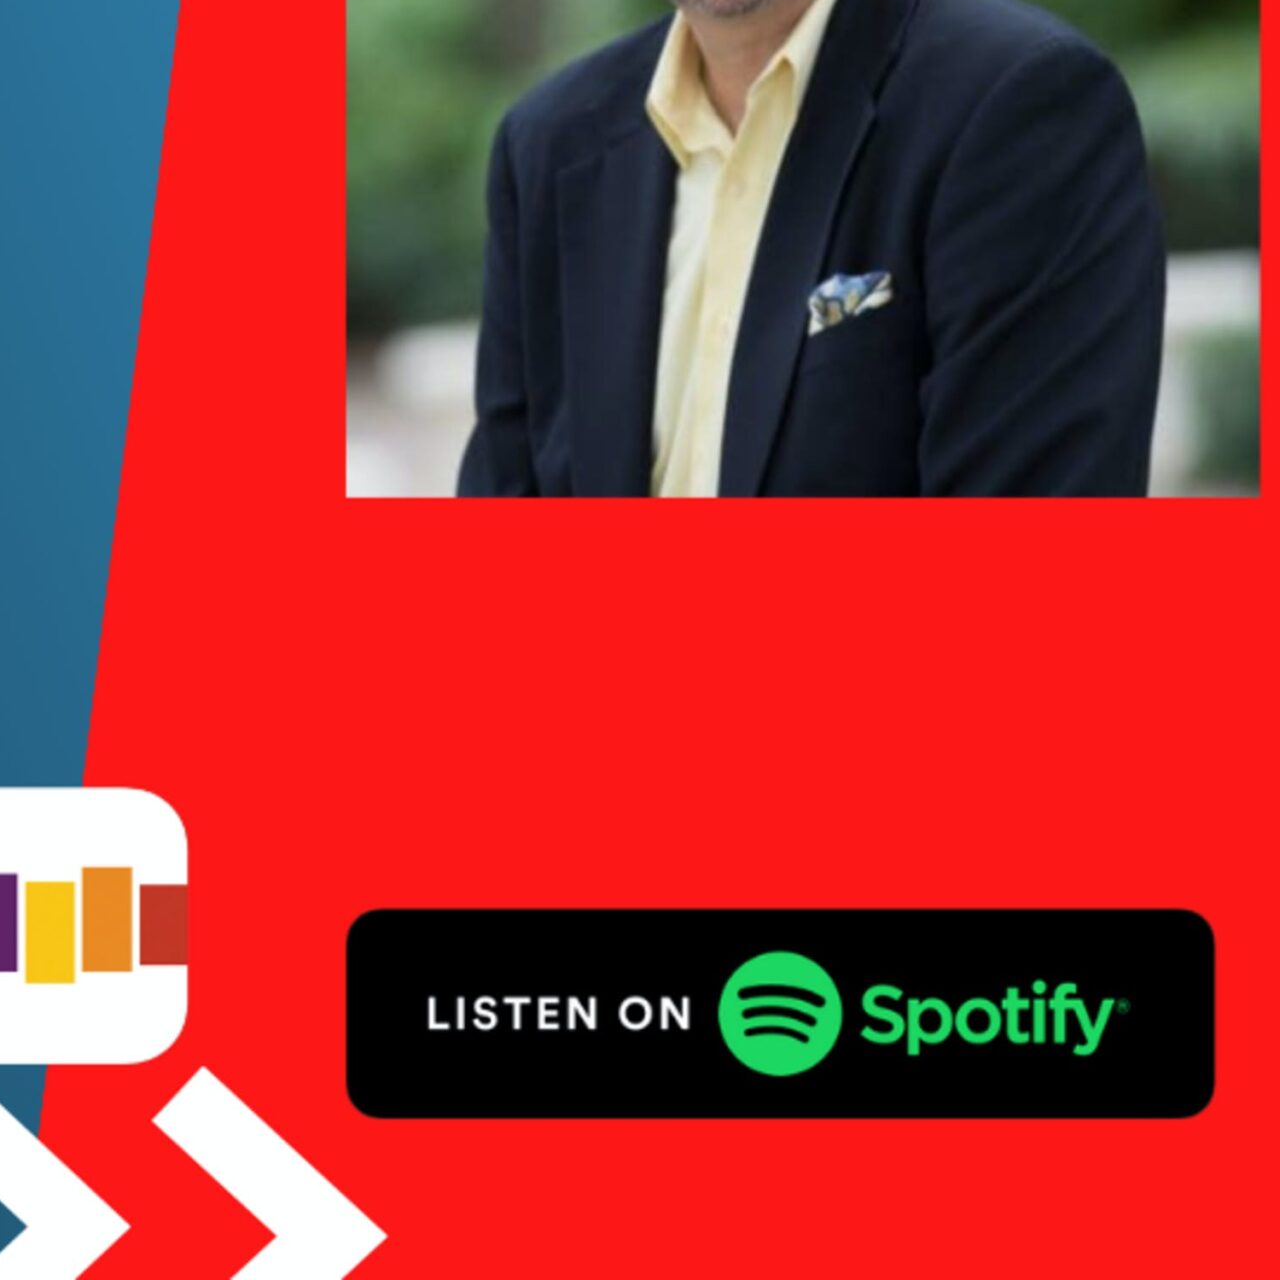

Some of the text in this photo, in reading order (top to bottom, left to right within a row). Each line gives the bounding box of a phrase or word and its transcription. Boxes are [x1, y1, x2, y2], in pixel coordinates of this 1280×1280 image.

[427, 979, 1115, 1057] LISTEN ON Spotify
